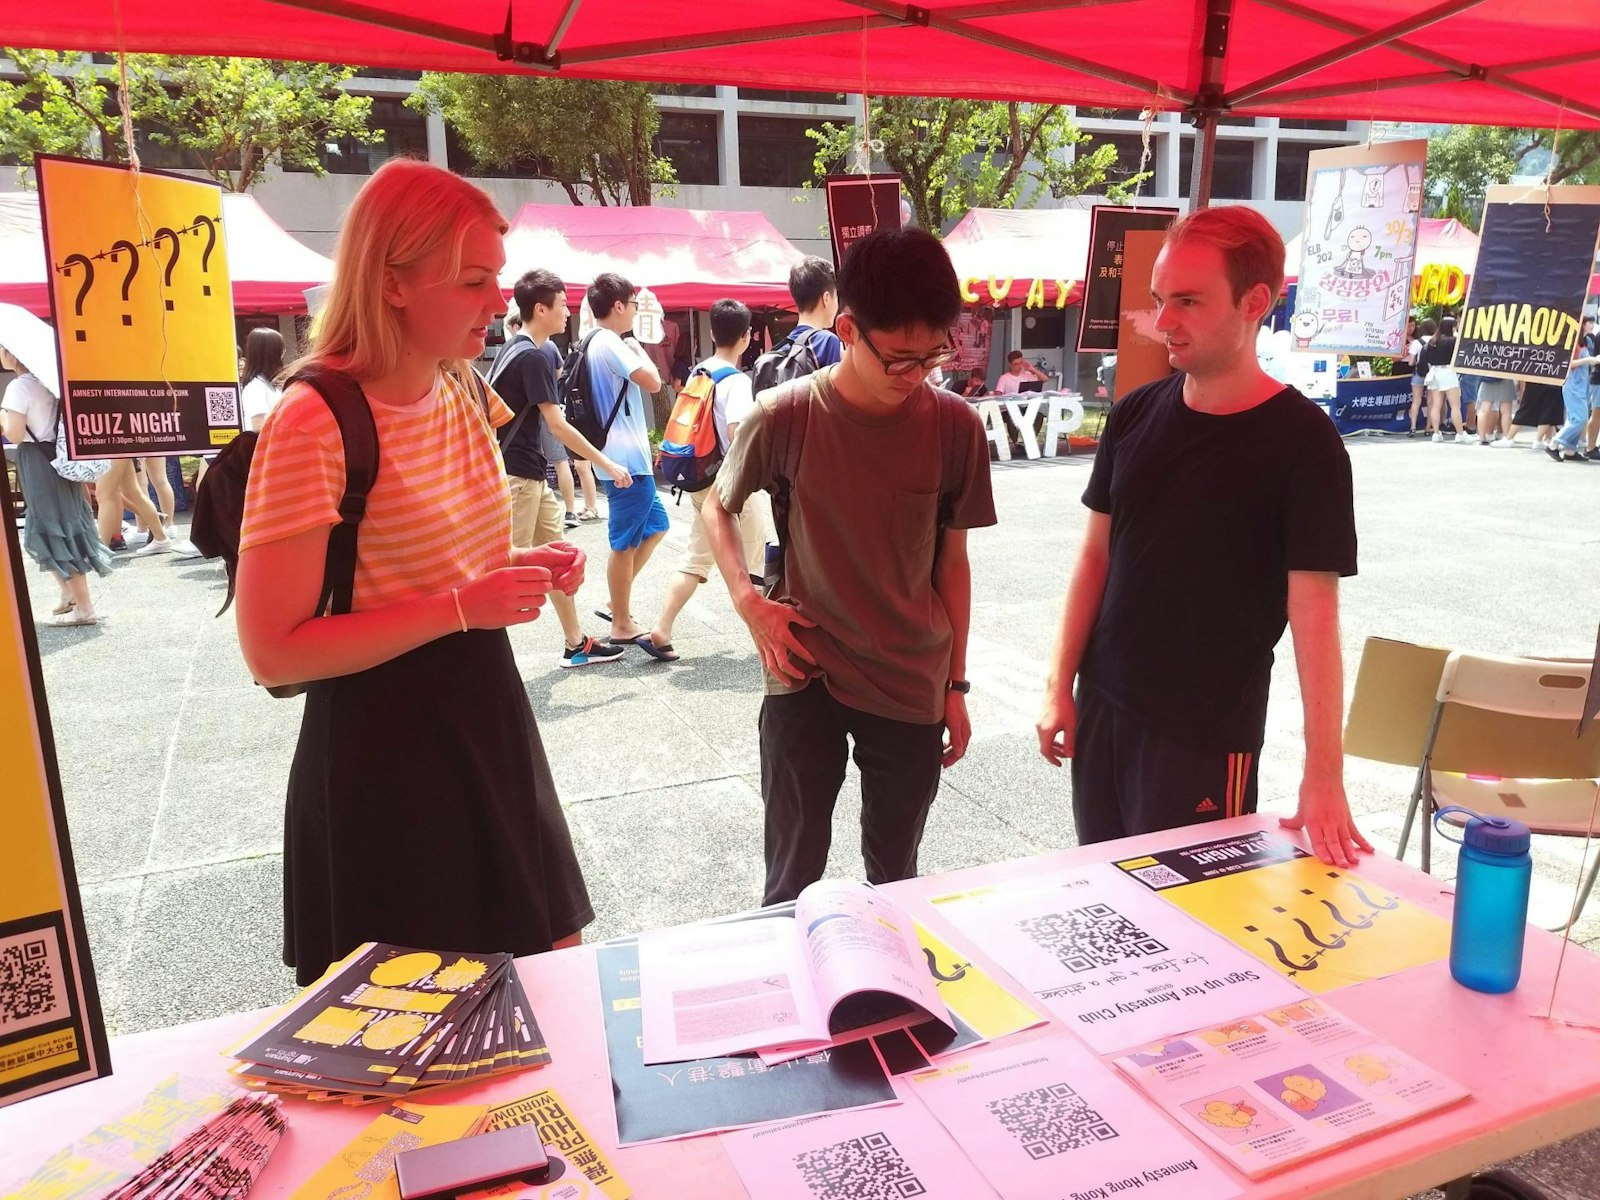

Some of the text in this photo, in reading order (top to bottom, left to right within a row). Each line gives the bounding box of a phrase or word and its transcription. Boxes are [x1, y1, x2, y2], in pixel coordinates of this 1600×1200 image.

[1307, 244, 1321, 256] ELB
[1317, 251, 1333, 264] 202
[1374, 245, 1393, 261] 7pm
[1463, 303, 1580, 351] INNAOUT
[1473, 343, 1556, 362] NA NIGHT 2016
[1463, 355, 1508, 369] MARCH
[1510, 360, 1522, 371] 17
[1534, 363, 1561, 376] 7PM
[72, 389, 102, 398] AMNESTY
[104, 389, 149, 398] INTERNATIONAL
[150, 389, 165, 397] CLUB
[76, 412, 181, 436] QUIZ NIGHT
[83, 437, 107, 445] October
[154, 435, 176, 443] Location
[1190, 846, 1246, 865] NIGHT
[1143, 959, 1181, 973] free
[1106, 971, 1127, 986] get
[1038, 982, 1086, 1000] sticker
[1078, 970, 1261, 1025] Sign up for Amnesty Club
[1070, 1160, 1199, 1200] Amnesty Hong Kong
